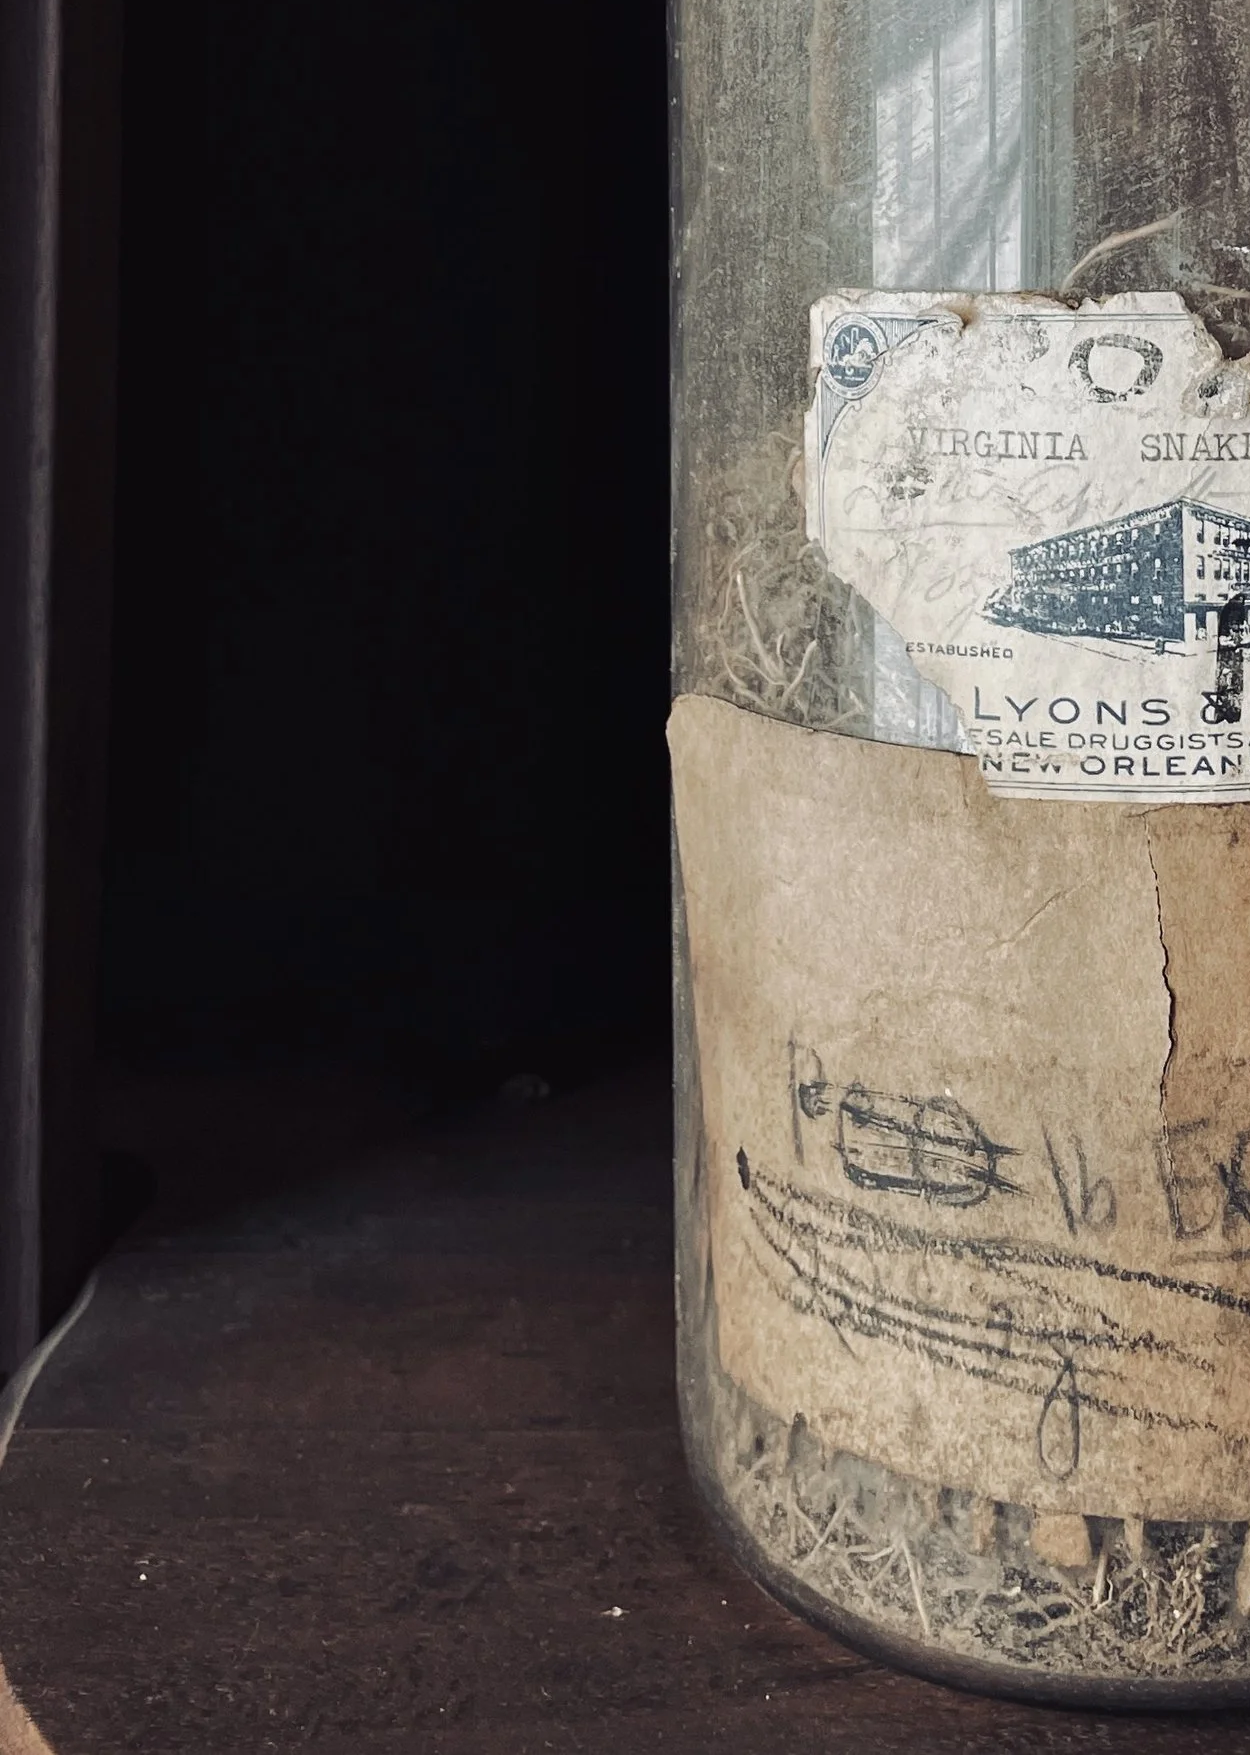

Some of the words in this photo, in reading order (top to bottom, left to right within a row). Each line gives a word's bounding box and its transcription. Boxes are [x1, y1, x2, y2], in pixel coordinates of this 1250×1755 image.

[907, 426, 1089, 461] VIRGINIA
[974, 686, 1172, 726] LYONS
[1067, 732, 1245, 751] DRUGGISTS
